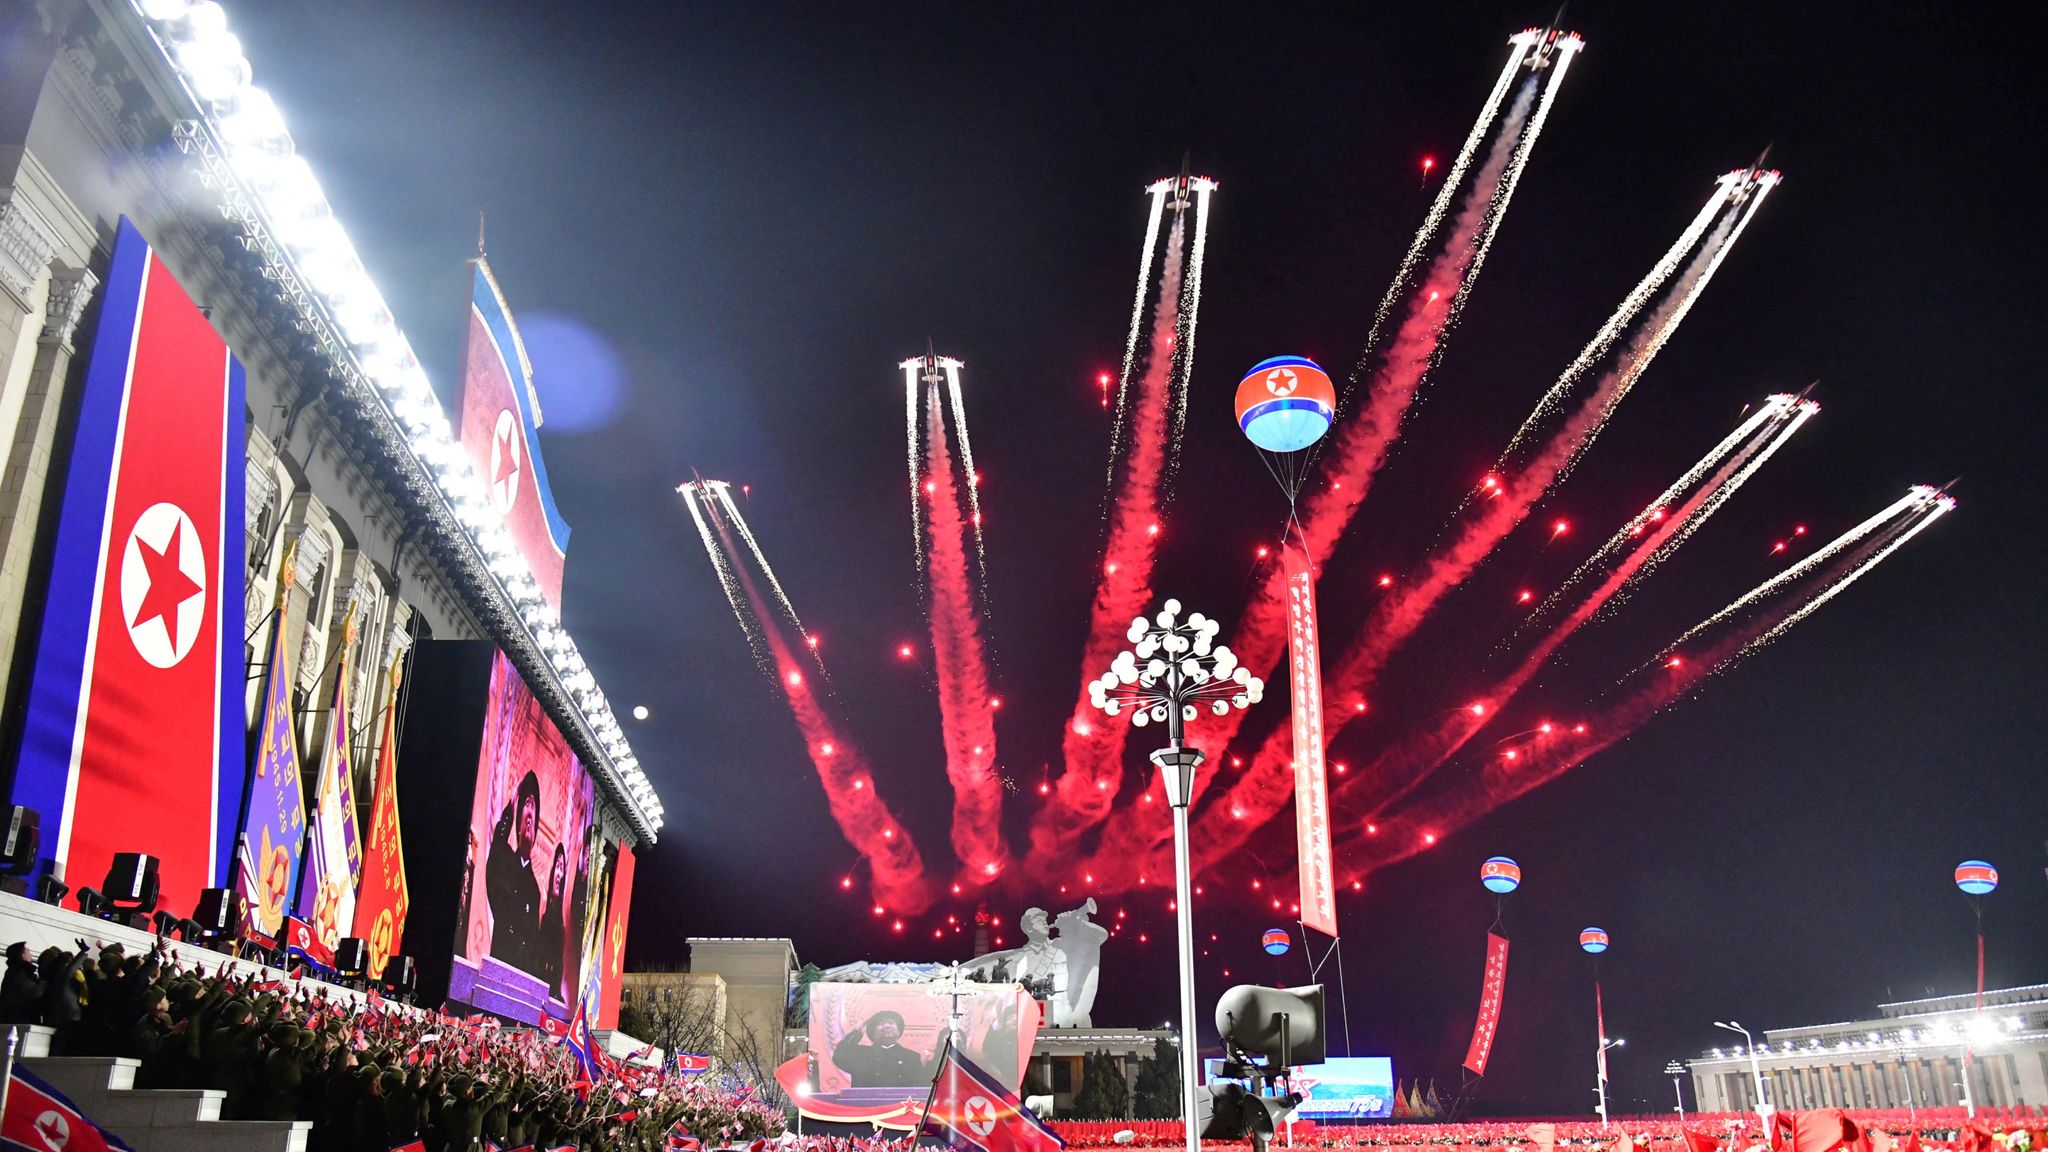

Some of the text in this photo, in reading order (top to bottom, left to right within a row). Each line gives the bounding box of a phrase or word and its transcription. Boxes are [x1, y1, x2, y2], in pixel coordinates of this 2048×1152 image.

[276, 697, 295, 786] 조국의
[337, 742, 352, 825] 조국의
[271, 743, 287, 834] 1945.11.29
[385, 782, 397, 857] 조국의
